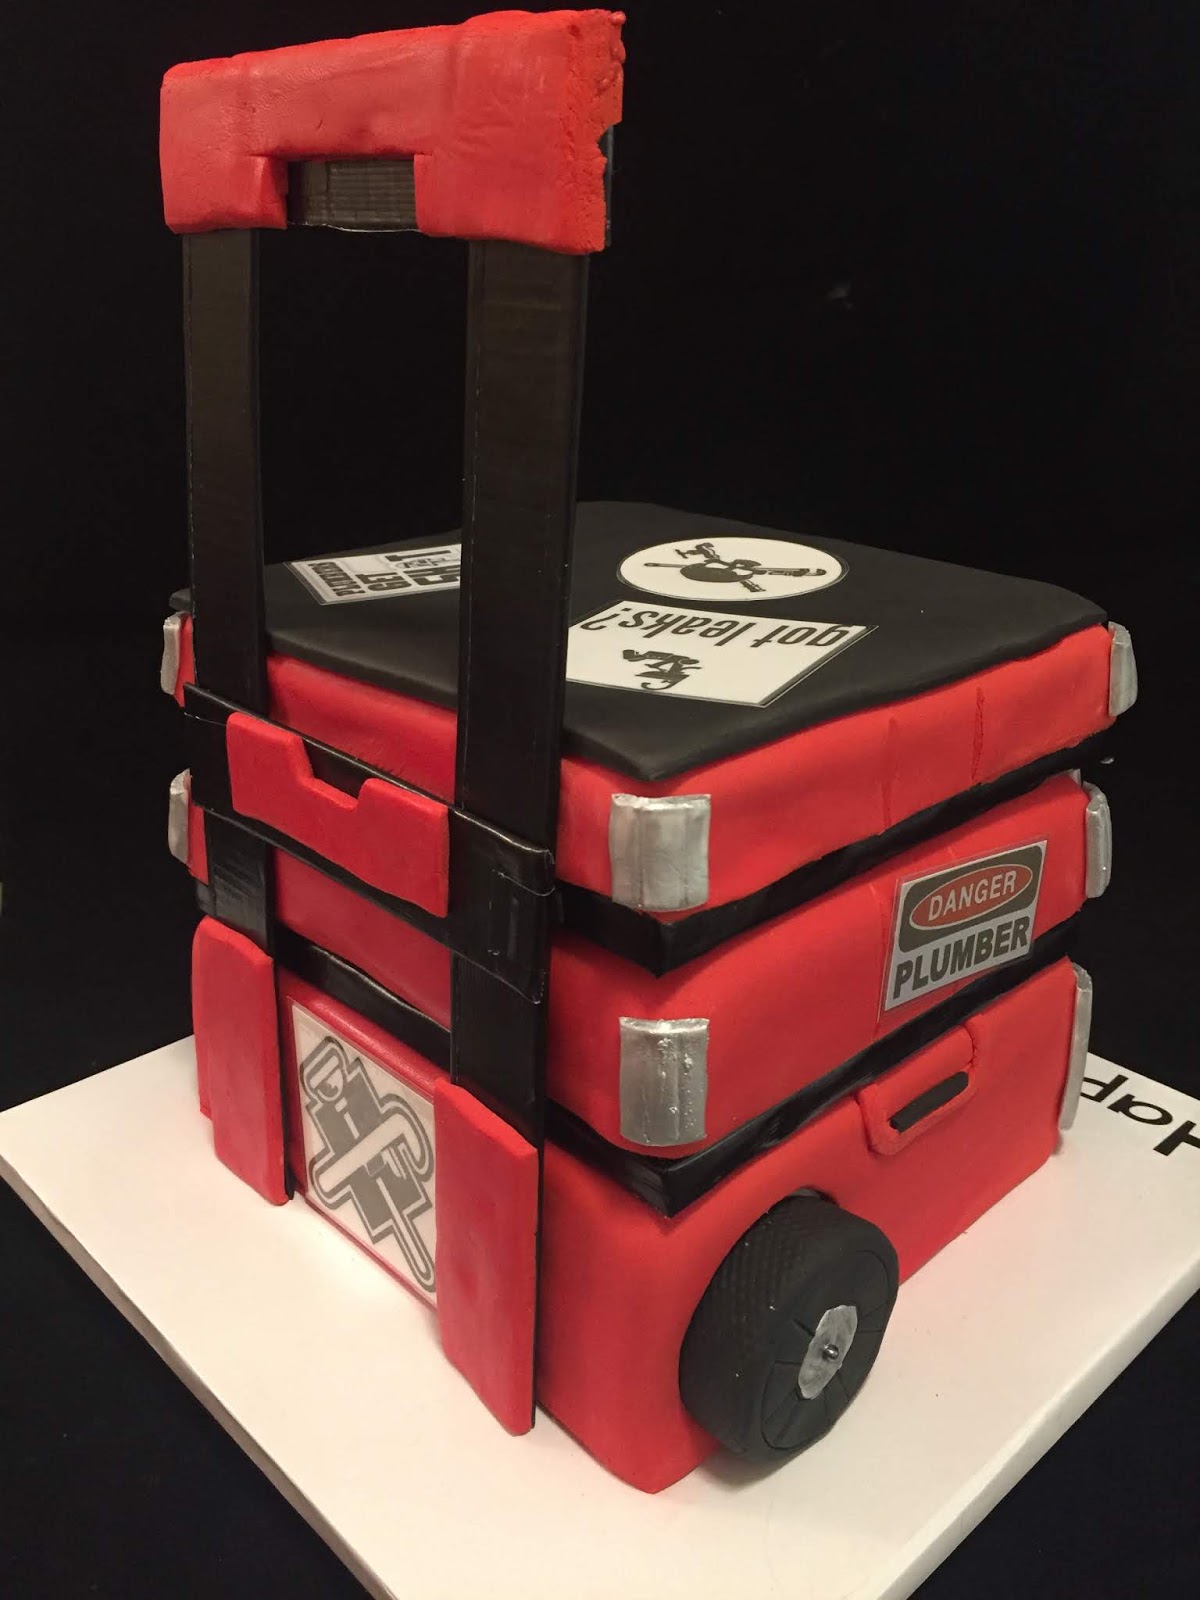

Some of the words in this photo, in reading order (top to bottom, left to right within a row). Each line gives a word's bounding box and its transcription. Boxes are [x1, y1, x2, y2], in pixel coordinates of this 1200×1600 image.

[355, 572, 412, 591] GET
[579, 607, 758, 647] leaks?
[749, 624, 851, 648] got
[928, 870, 1018, 922] DANGER
[893, 915, 1031, 1000] PLUMBER
